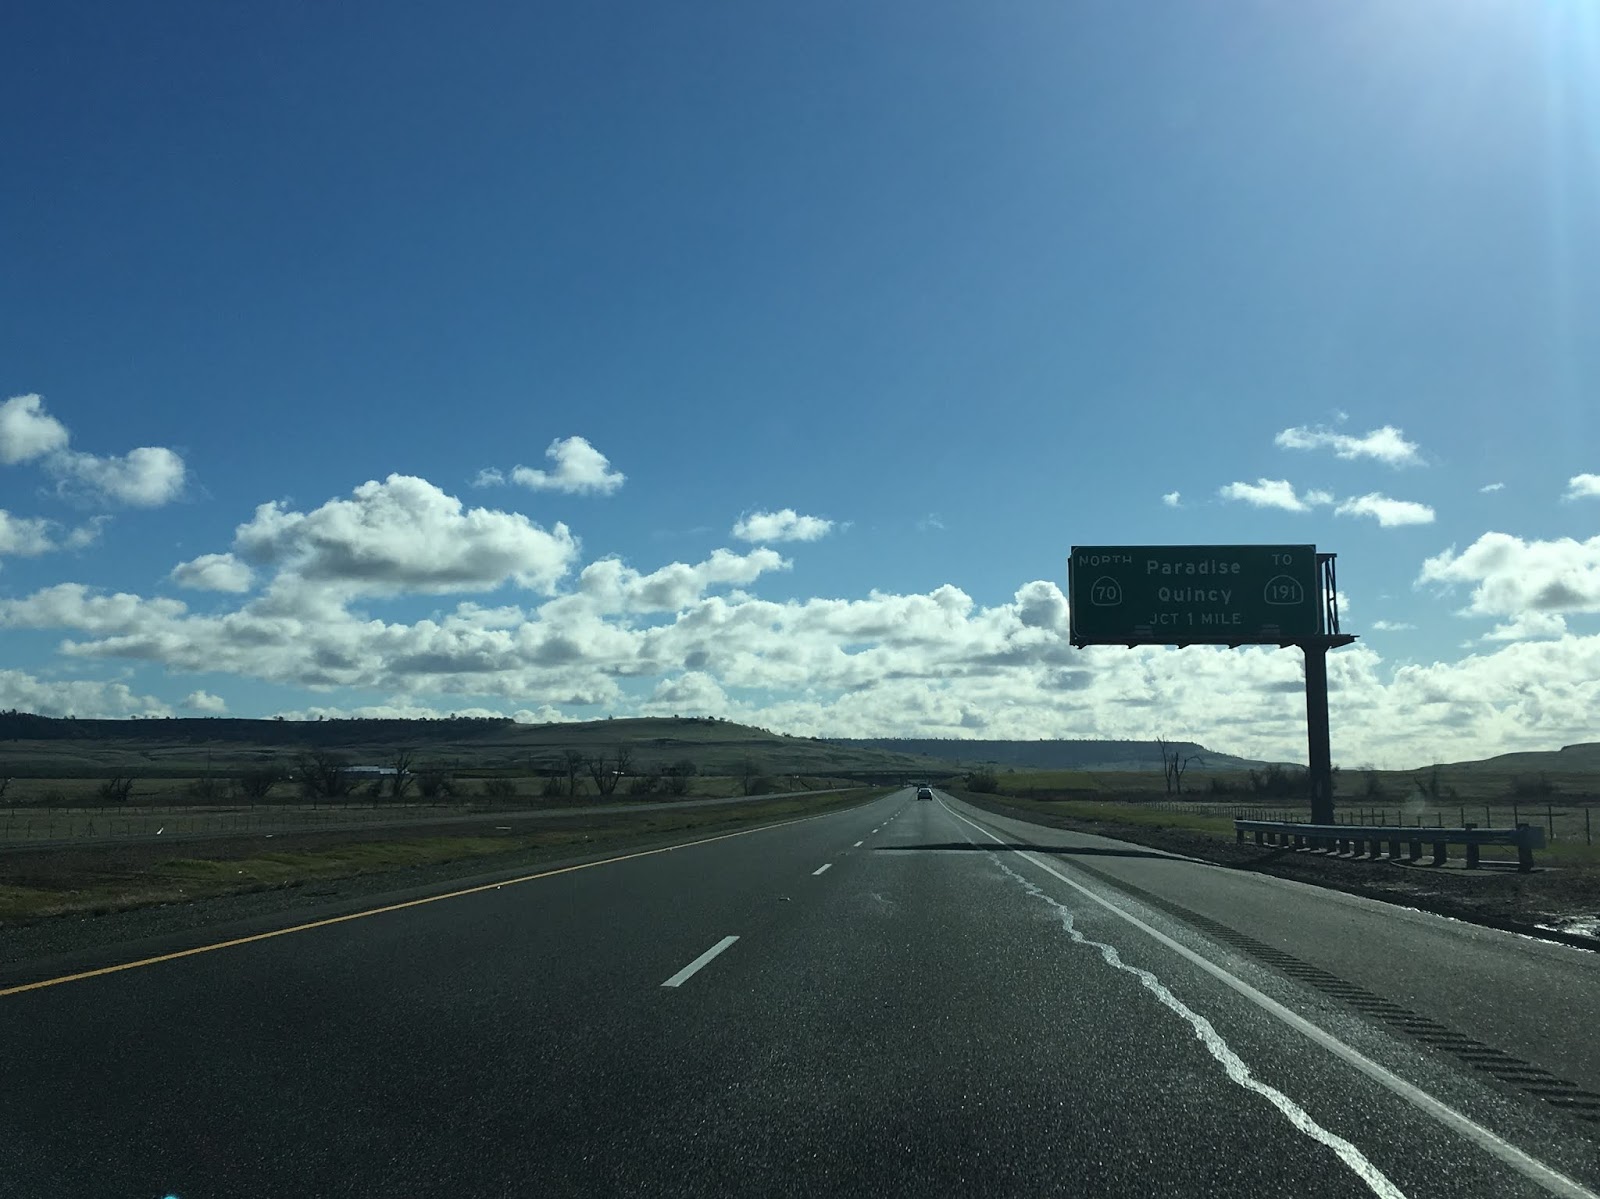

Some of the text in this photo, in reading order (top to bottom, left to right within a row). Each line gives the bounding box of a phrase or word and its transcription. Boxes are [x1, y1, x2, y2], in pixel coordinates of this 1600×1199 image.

[1079, 555, 1132, 567] NORTH
[1146, 559, 1242, 575] Paradise
[1271, 554, 1293, 566] TO
[1096, 586, 1117, 600] 70
[1158, 587, 1232, 605] Quincy
[1271, 585, 1296, 599] 191
[1149, 612, 1242, 625] JCT 1 MILE
